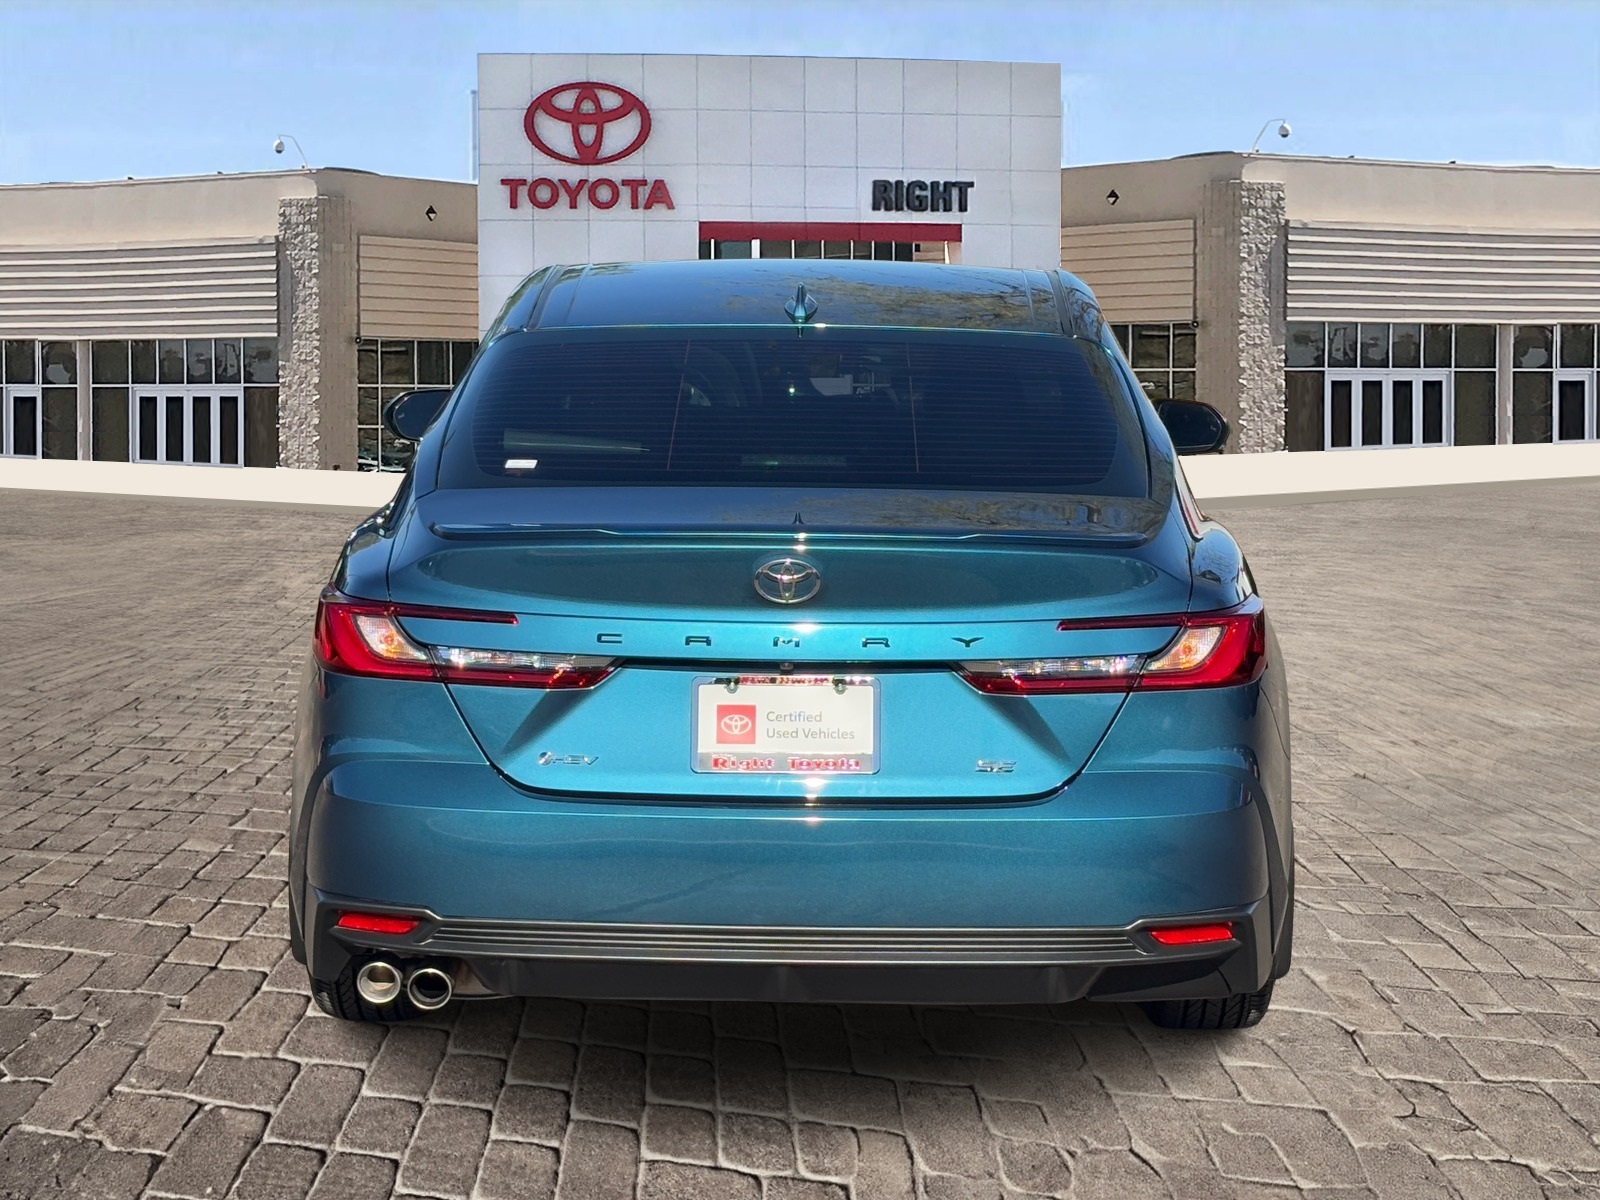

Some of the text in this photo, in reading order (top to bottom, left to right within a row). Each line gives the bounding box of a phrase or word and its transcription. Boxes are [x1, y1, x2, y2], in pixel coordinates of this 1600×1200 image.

[500, 177, 675, 210] TOYOTA
[871, 179, 975, 212] RIGHT
[596, 632, 984, 648] CAMRY
[766, 711, 822, 723] Certified
[766, 728, 855, 740] Used Vehicles
[711, 755, 860, 771] Right Toyota
